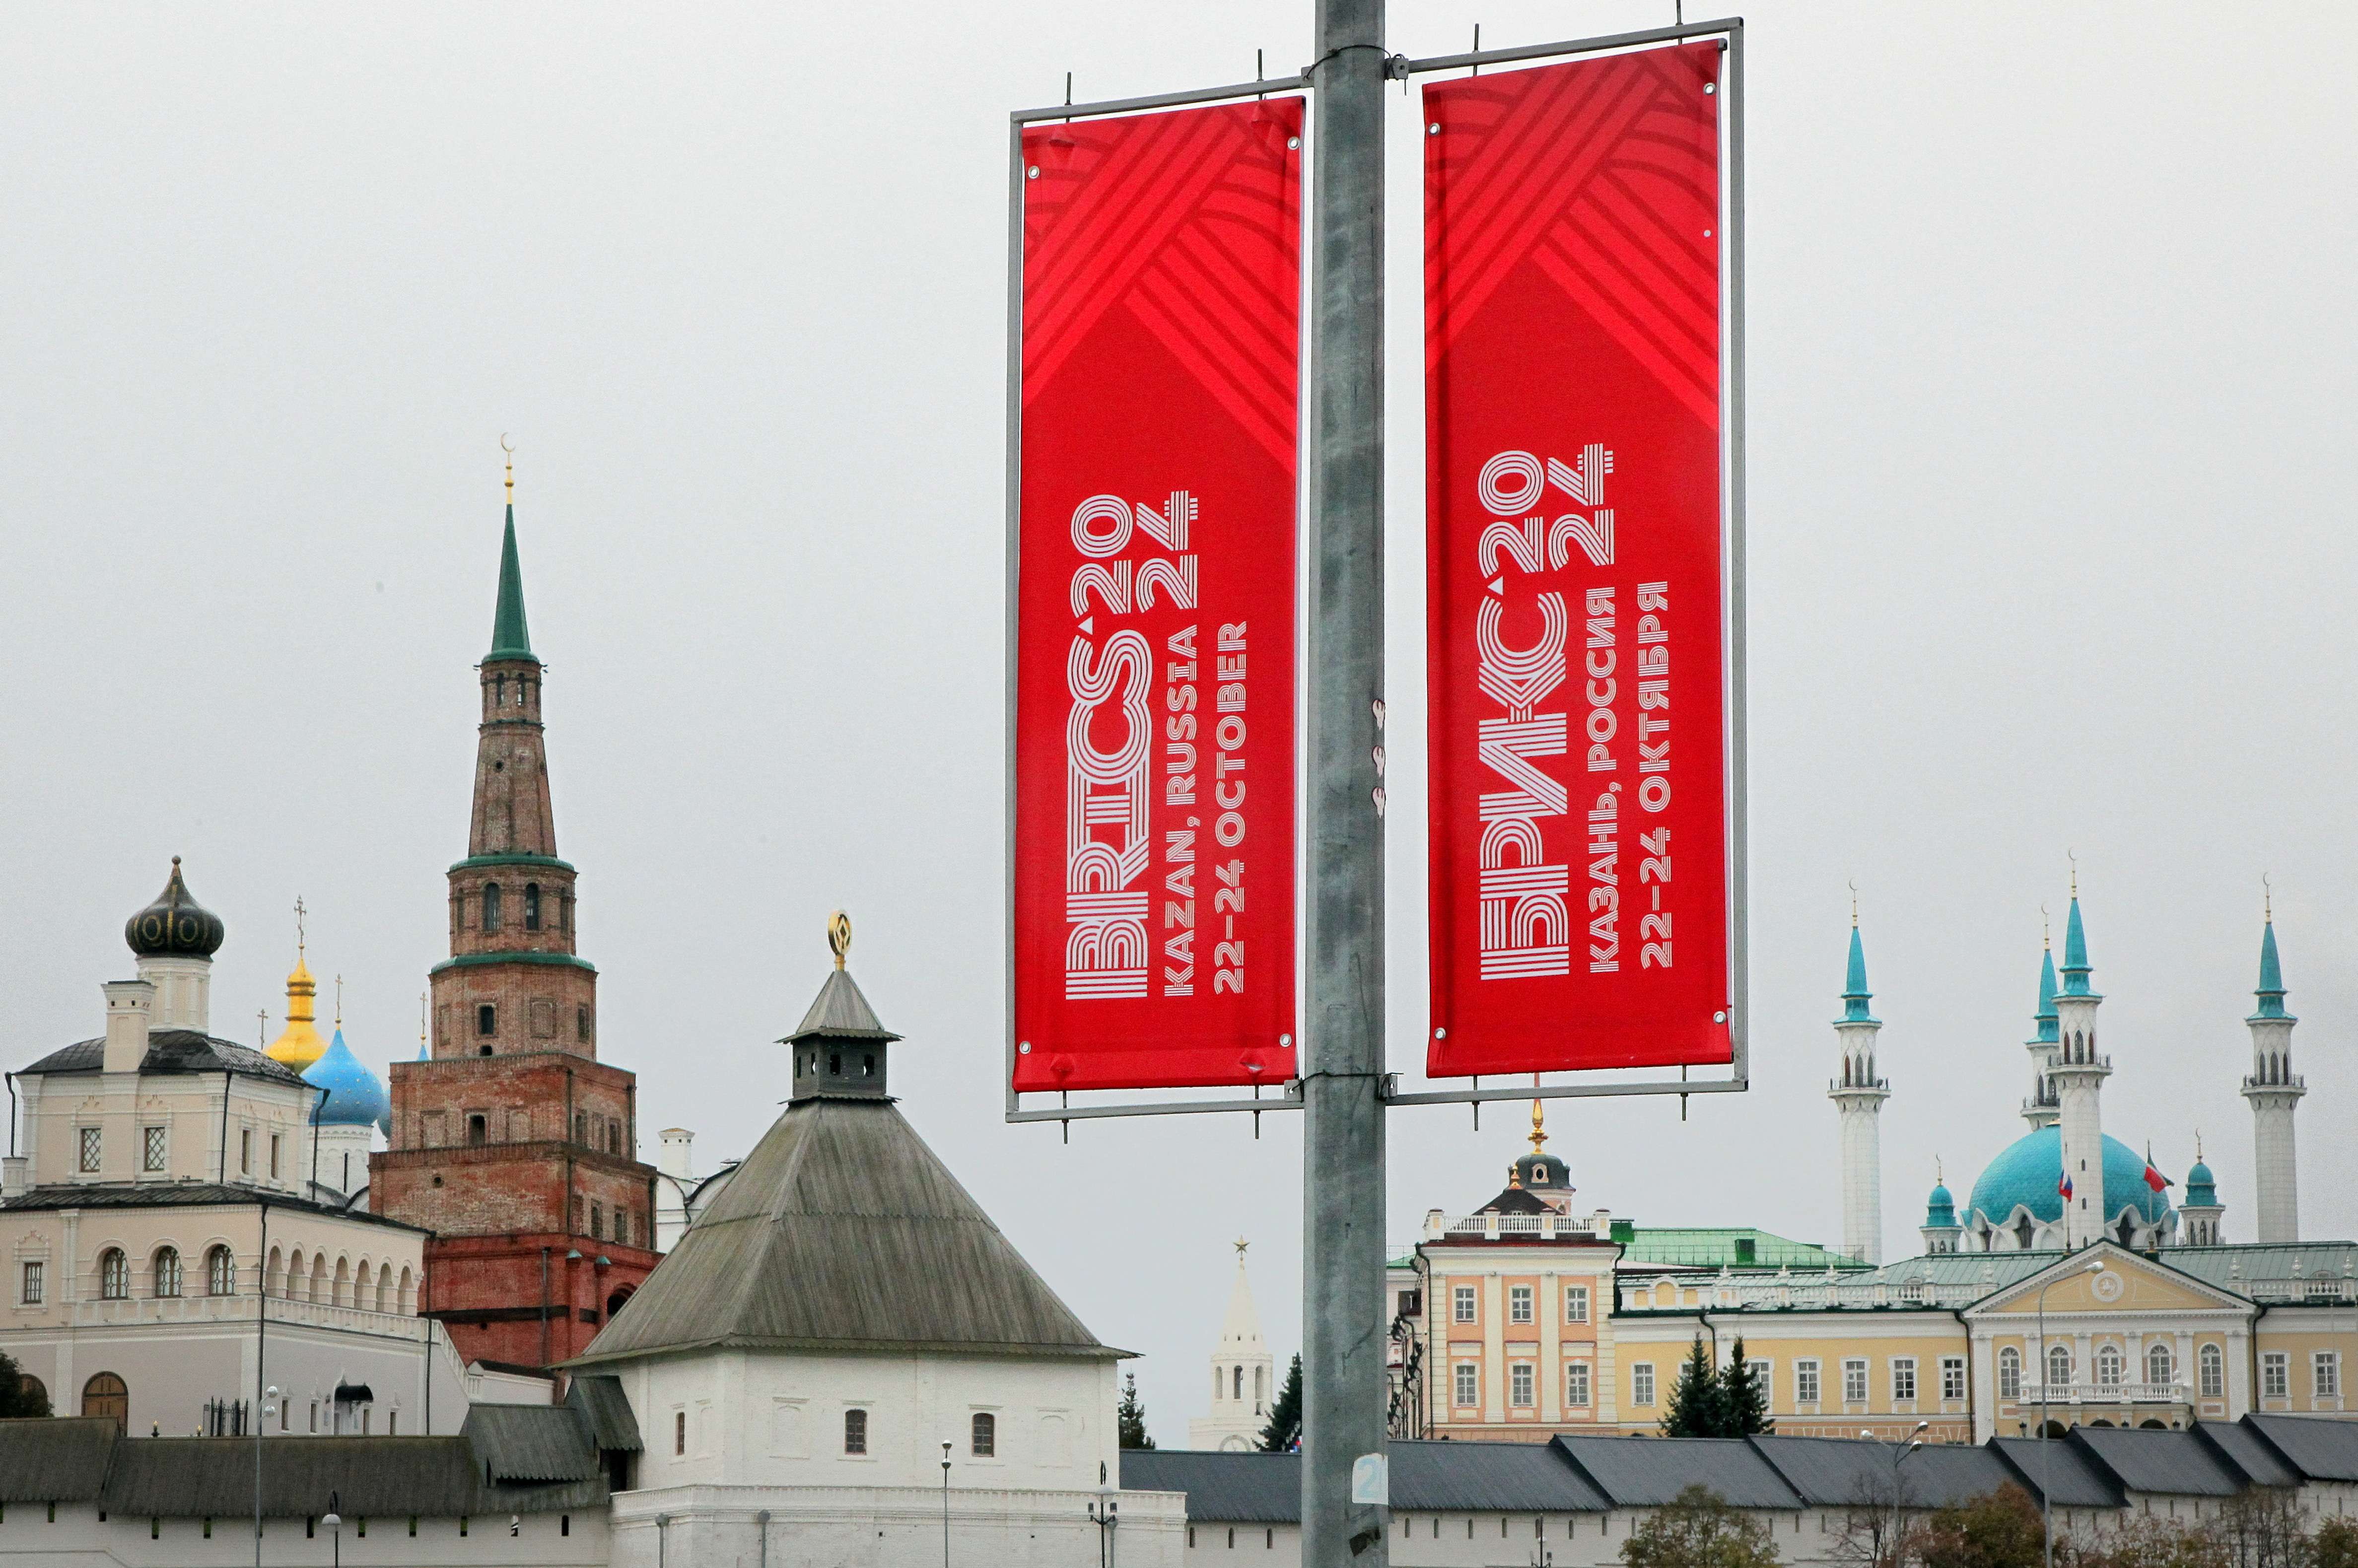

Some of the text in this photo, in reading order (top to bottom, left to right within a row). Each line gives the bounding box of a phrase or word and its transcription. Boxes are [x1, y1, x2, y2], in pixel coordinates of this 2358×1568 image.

[1070, 494, 1133, 618] 20
[1136, 490, 1198, 613] 24
[1478, 450, 1544, 579] 20
[1547, 443, 1614, 571] 24
[1164, 624, 1200, 995] KAZAN, RUSSIA
[1215, 621, 1247, 848] OCTOBER
[1476, 592, 1570, 980] БРИКС
[1586, 587, 1622, 973] КАЗАНЬ, РОССИЯ
[1637, 581, 1671, 813] ОКТЯБРЯ
[1065, 629, 1153, 1000] BRICS
